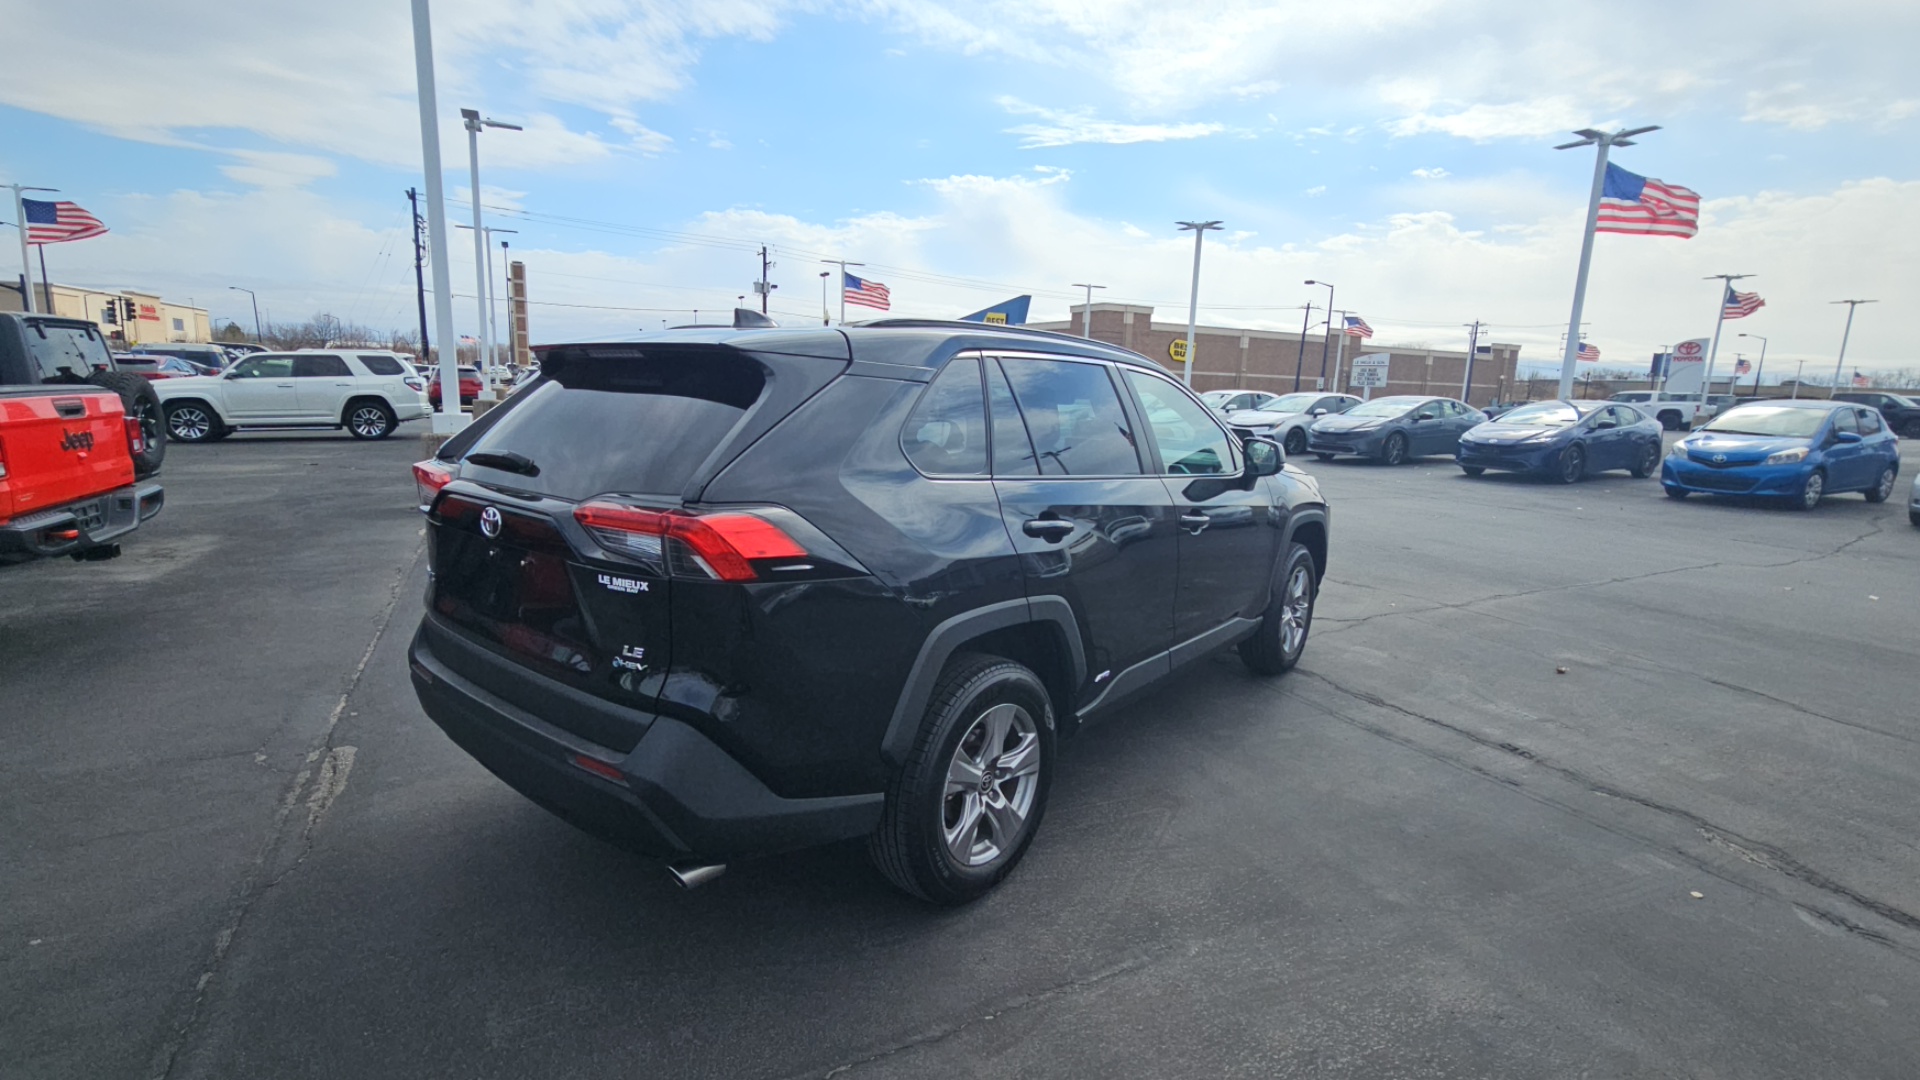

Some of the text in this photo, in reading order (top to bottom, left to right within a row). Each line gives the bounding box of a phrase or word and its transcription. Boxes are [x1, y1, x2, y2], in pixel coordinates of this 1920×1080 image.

[60, 428, 94, 452] Jeep
[598, 574, 649, 592] LE MIEUX
[622, 645, 645, 659] LE
